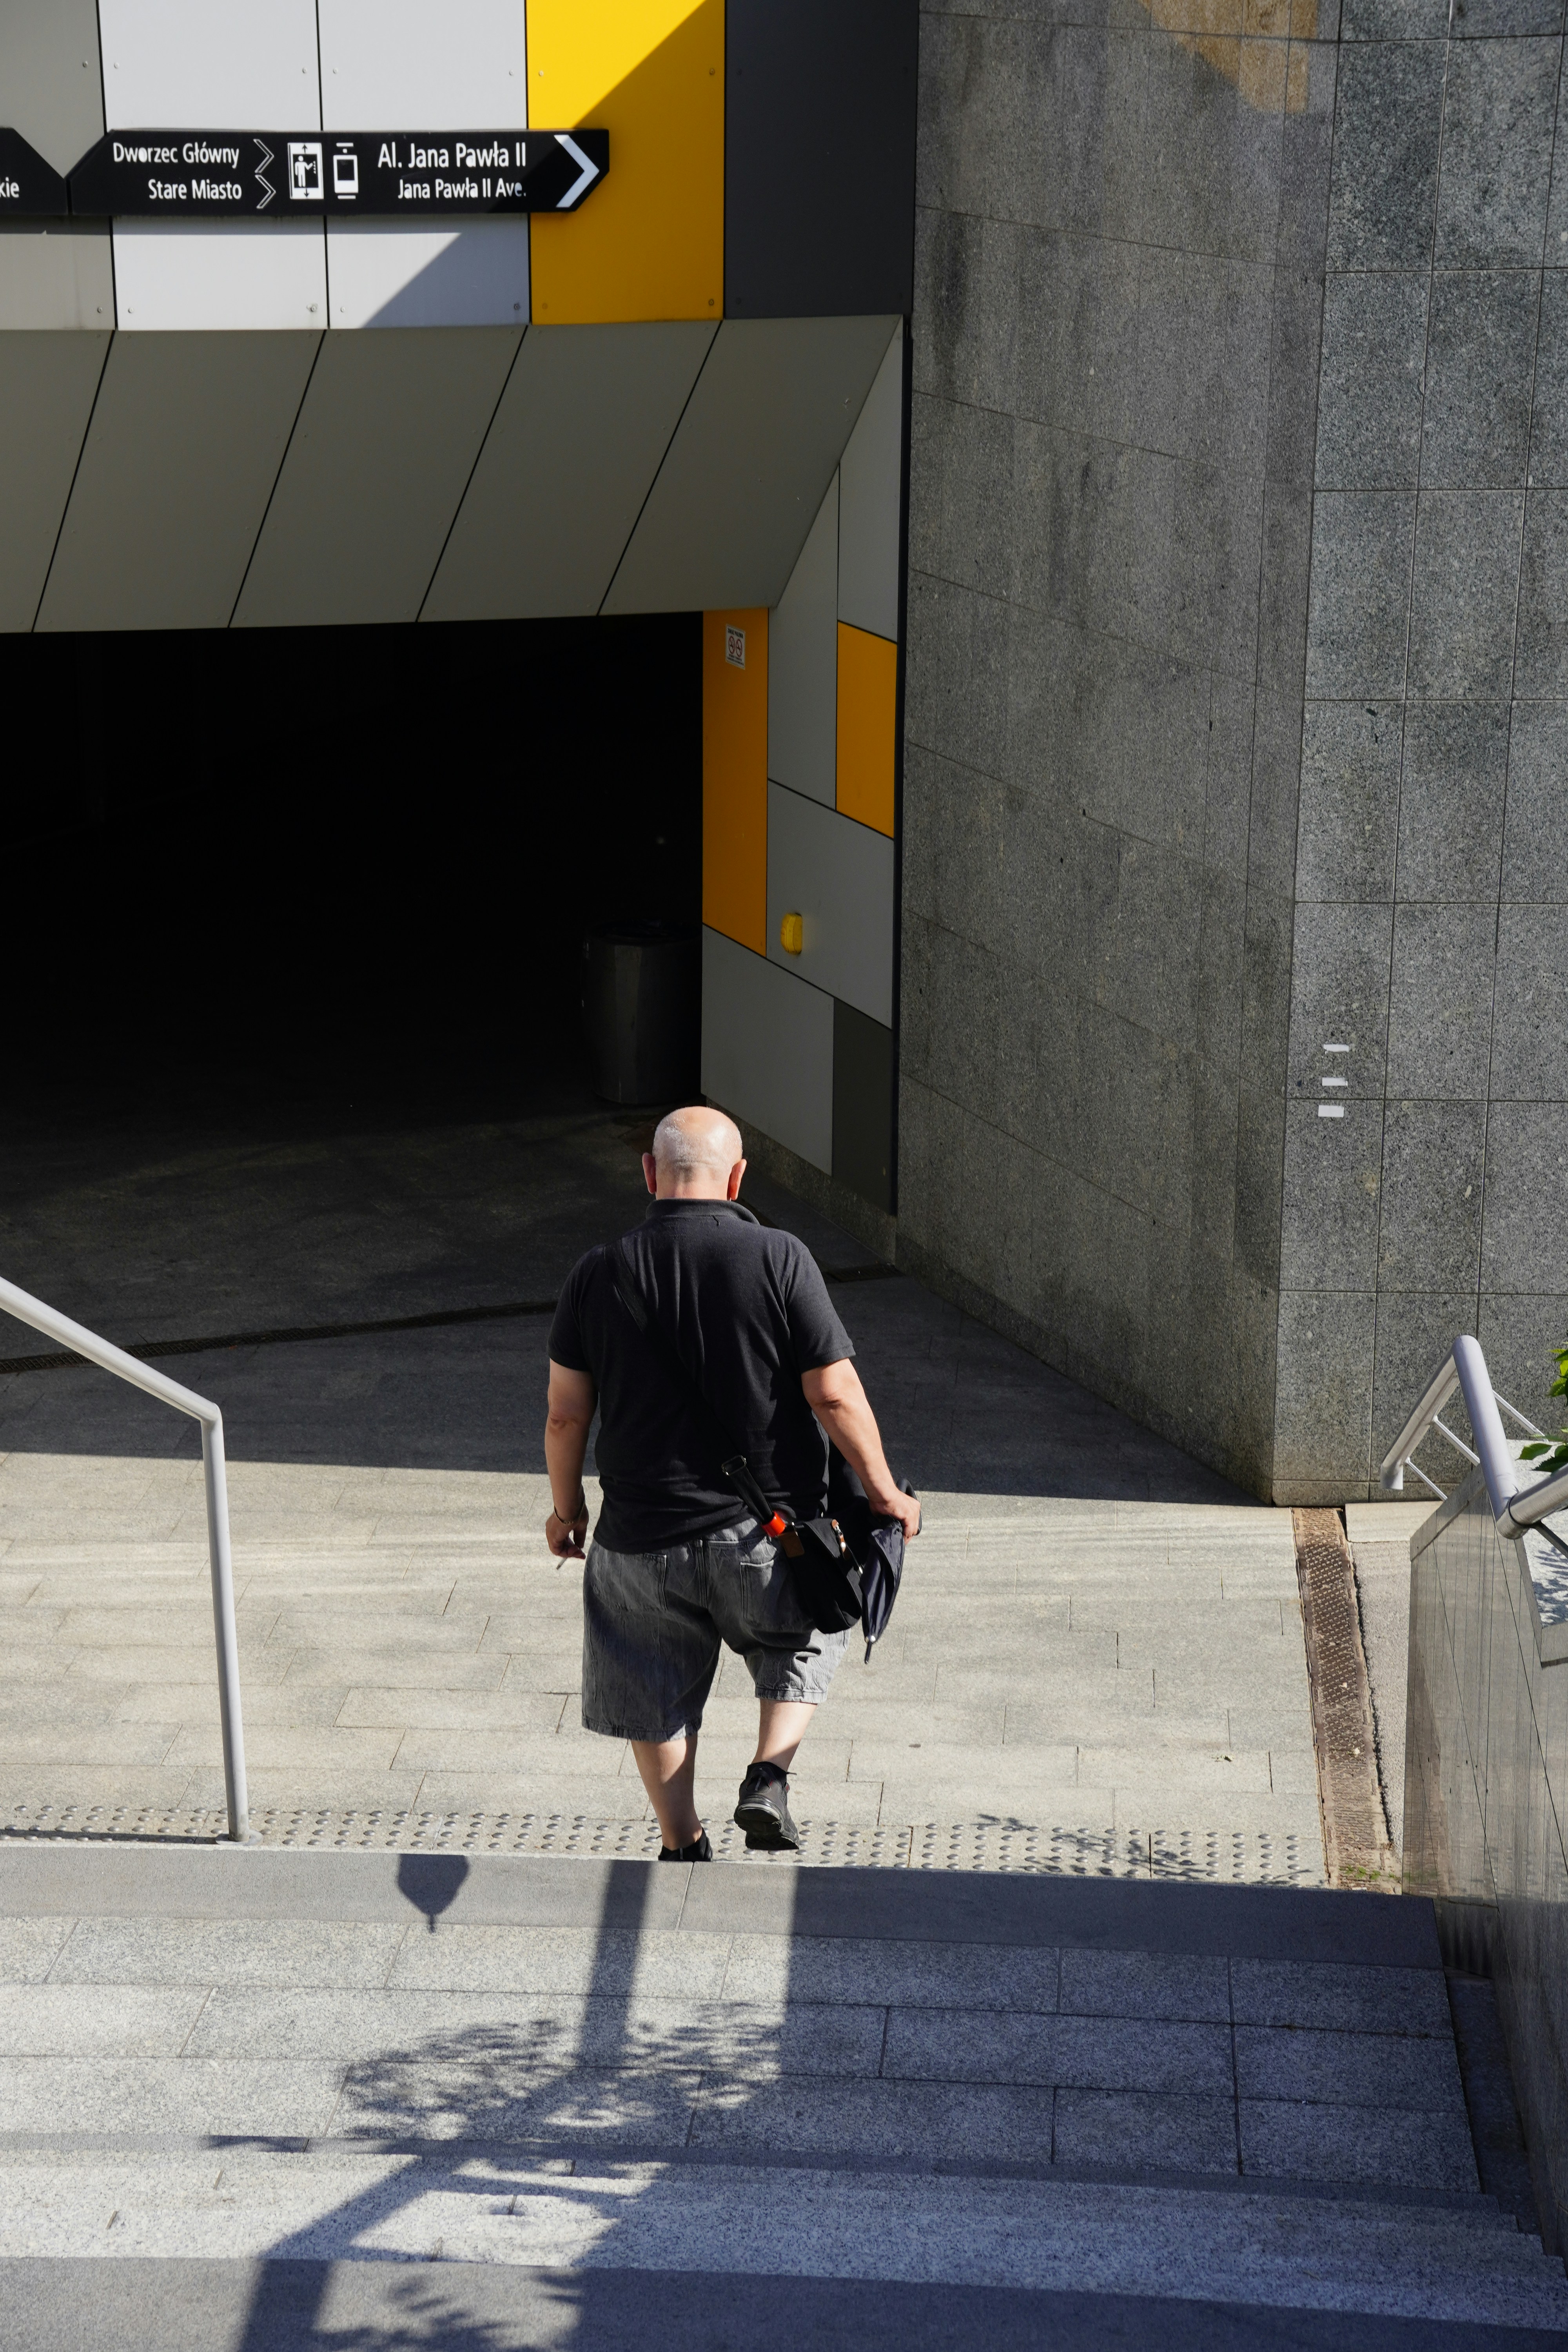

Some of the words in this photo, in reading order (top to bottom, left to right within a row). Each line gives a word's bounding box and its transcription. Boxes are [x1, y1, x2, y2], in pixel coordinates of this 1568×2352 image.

[113, 142, 178, 163] Dworzec
[182, 141, 240, 169] Główny
[377, 141, 402, 168] Al.
[408, 143, 449, 168] Jana
[456, 141, 509, 168] Pawła
[515, 142, 526, 167] II
[148, 179, 187, 200] Stare
[191, 179, 242, 200] Miasto
[397, 179, 430, 199] Jana
[435, 177, 479, 199] Pawła
[482, 178, 491, 198] II
[495, 178, 526, 198] Ave.
